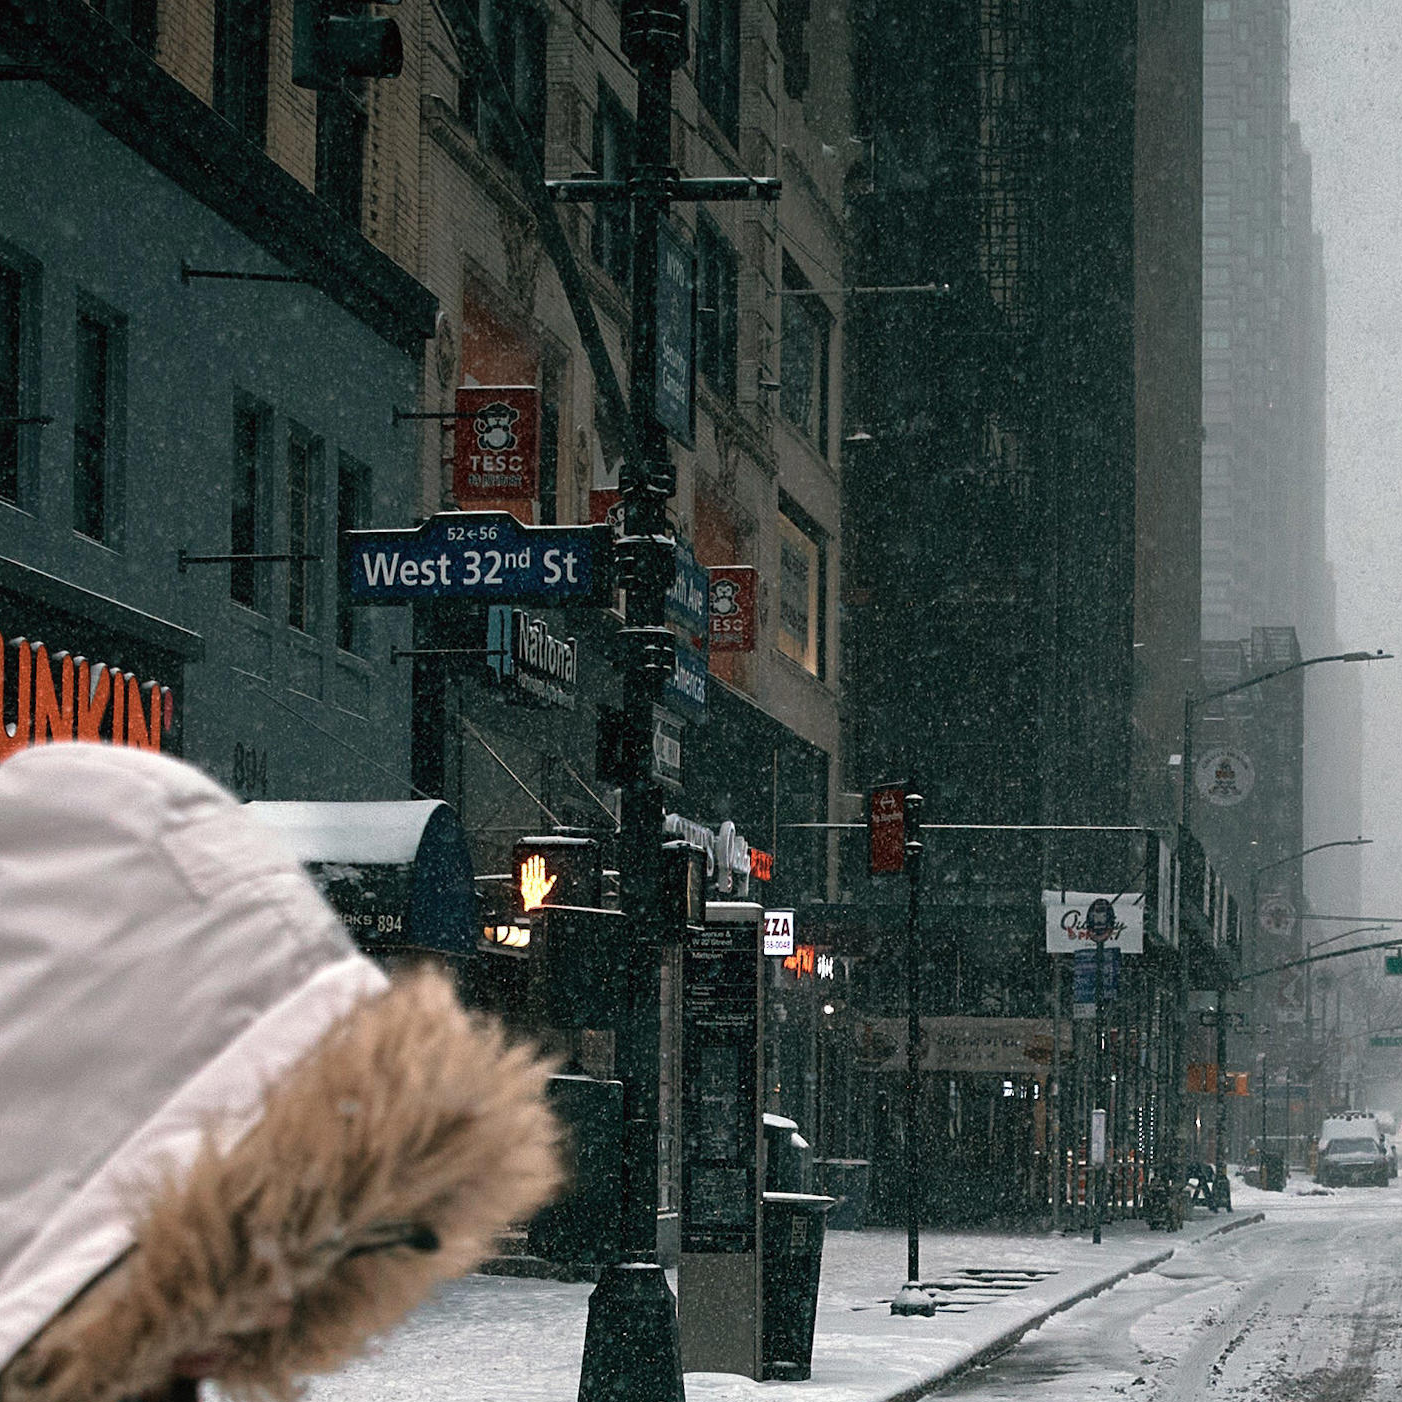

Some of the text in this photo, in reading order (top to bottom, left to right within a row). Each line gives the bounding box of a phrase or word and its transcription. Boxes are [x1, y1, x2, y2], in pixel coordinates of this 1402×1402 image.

[362, 547, 579, 587] West 32nd St
[518, 612, 579, 685] National
[376, 914, 402, 933] 894
